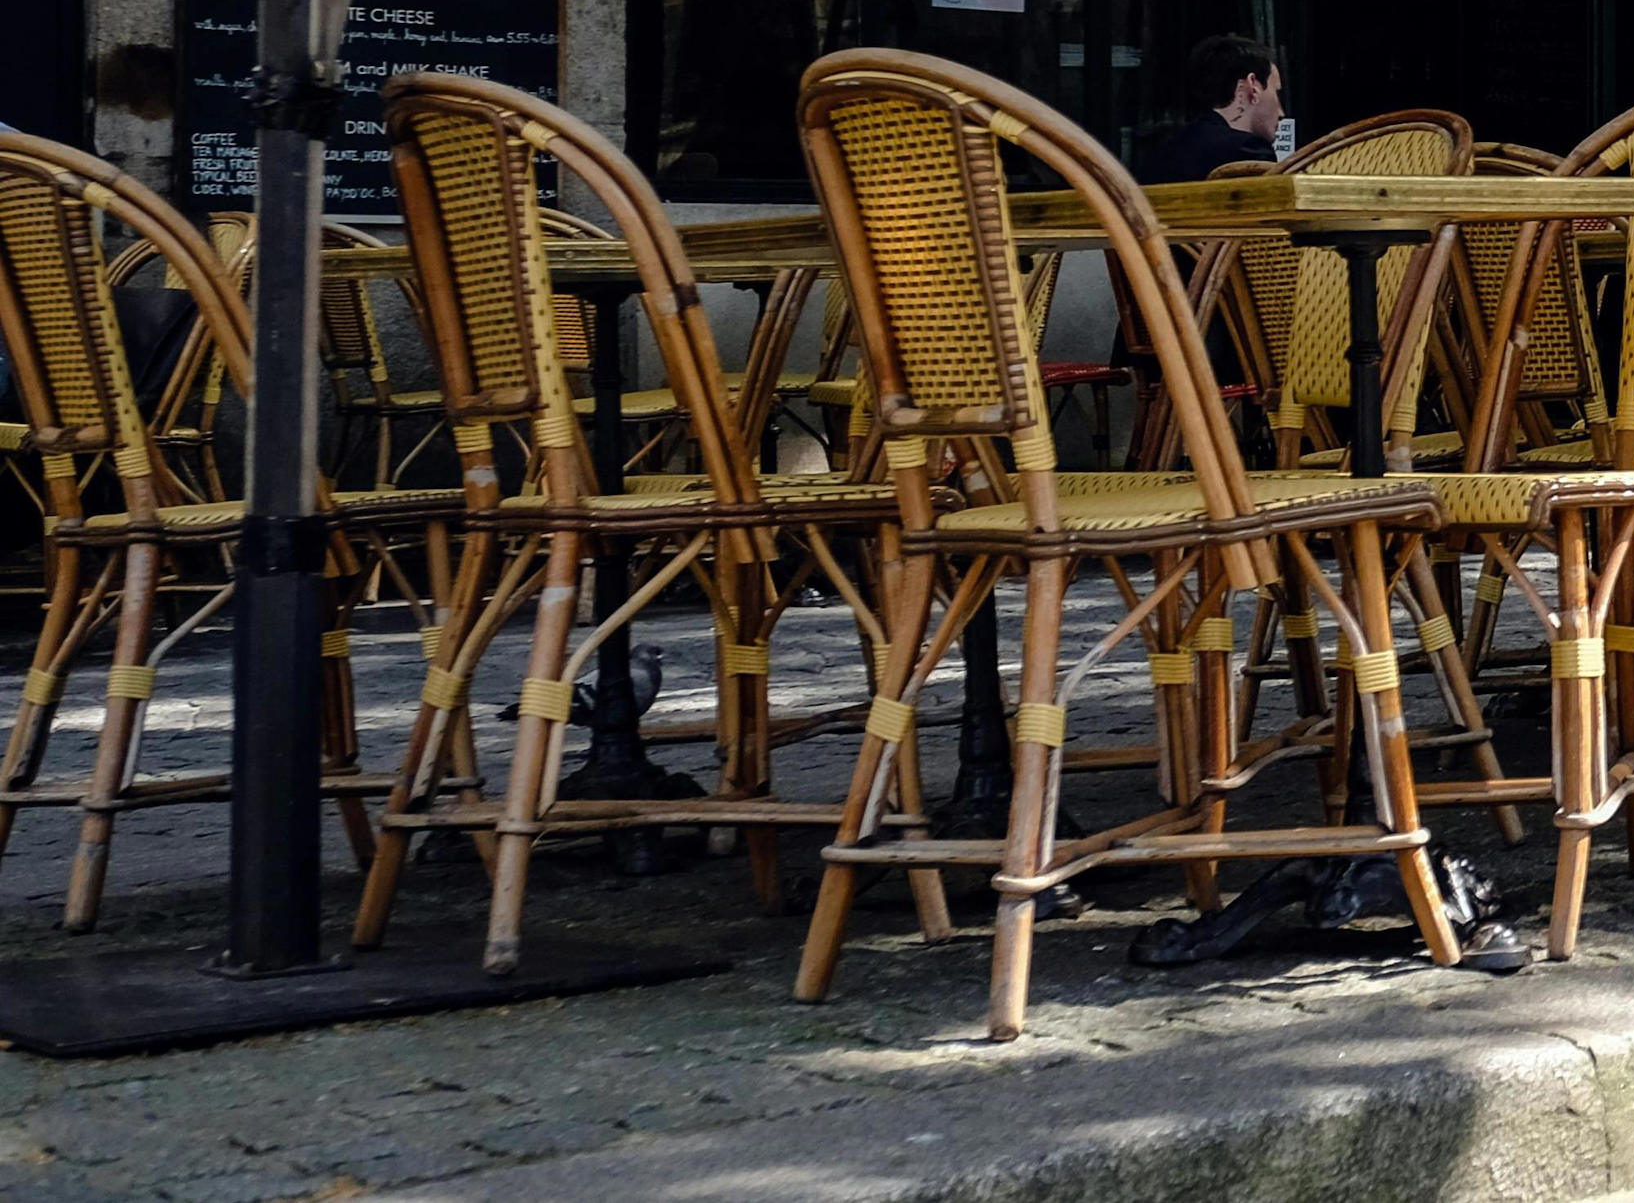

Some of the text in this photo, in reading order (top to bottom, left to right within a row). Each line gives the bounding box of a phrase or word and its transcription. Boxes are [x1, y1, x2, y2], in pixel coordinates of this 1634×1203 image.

[370, 8, 437, 27] CHEESE
[356, 60, 388, 78] and
[191, 132, 239, 146] COFFEE
